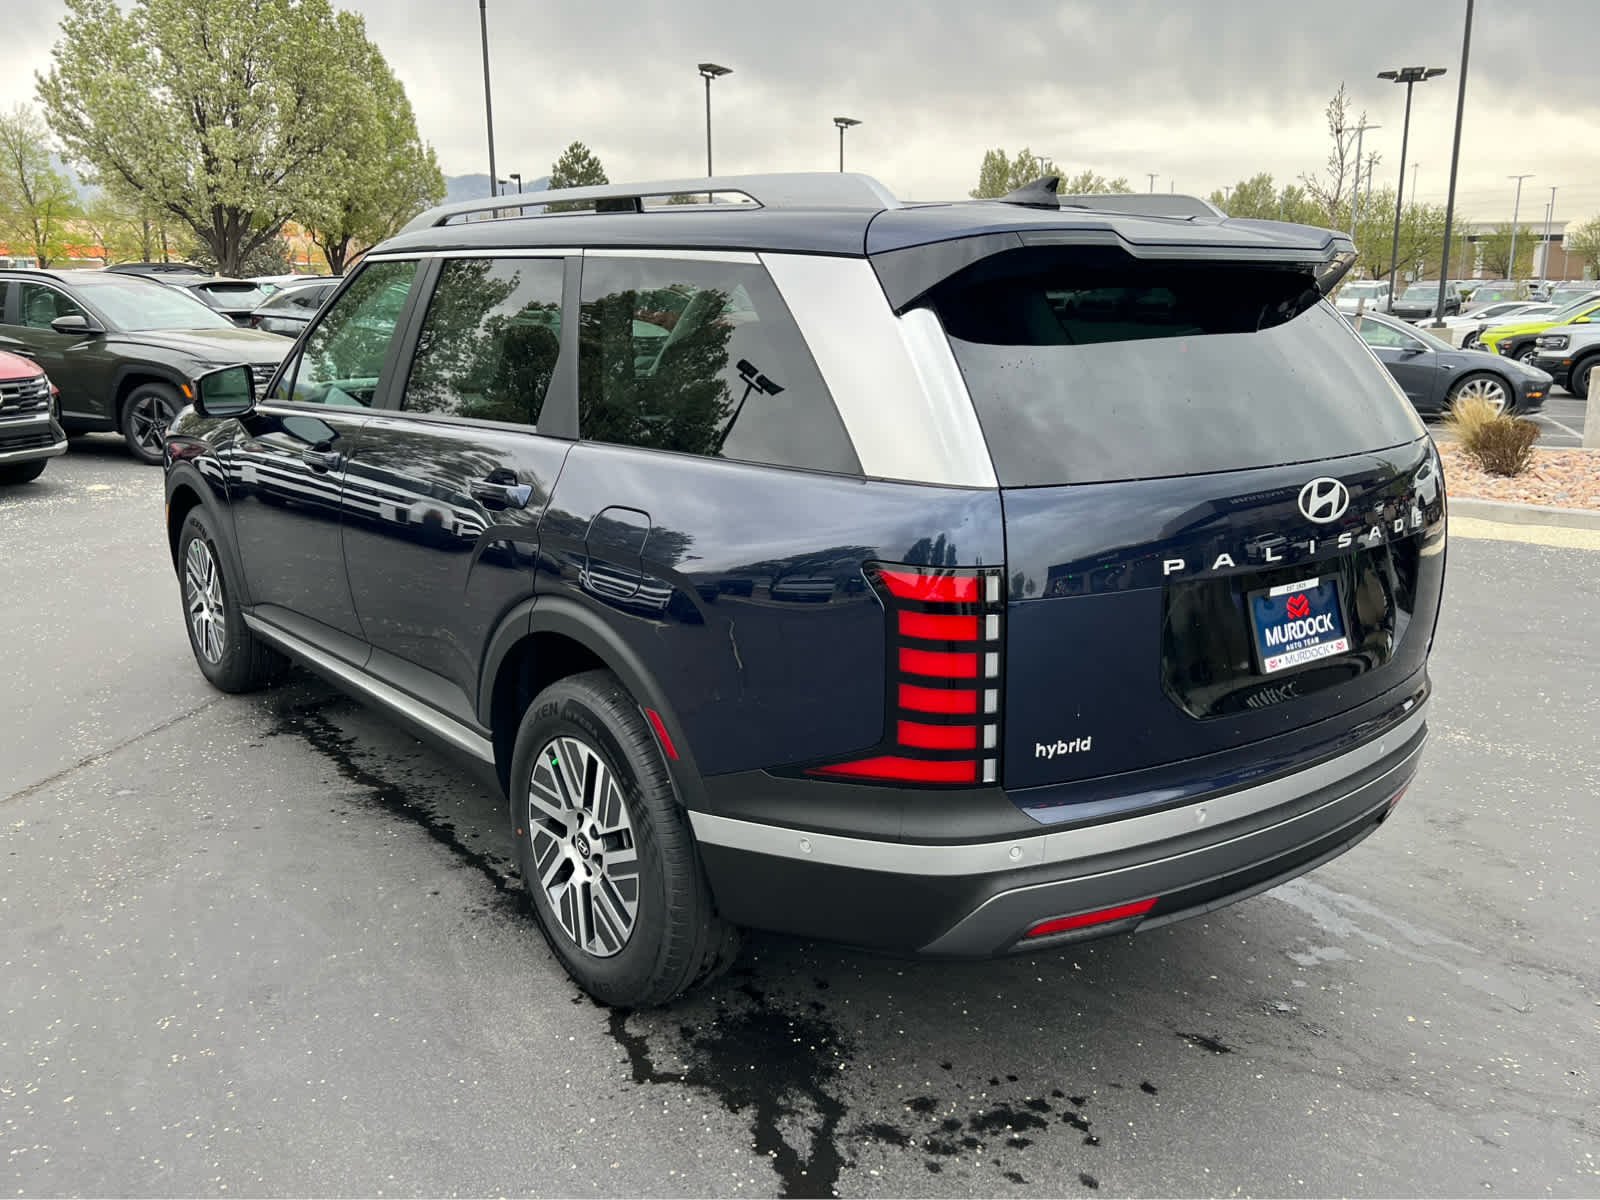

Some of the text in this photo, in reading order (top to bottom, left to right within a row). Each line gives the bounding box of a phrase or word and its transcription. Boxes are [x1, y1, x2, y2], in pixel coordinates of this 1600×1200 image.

[1163, 505, 1423, 576] PALISADE
[1264, 612, 1334, 647] MURDOCK
[1285, 645, 1331, 664] MURDOCK
[1286, 640, 1302, 651] AUTO
[1035, 735, 1092, 760] hybrid
